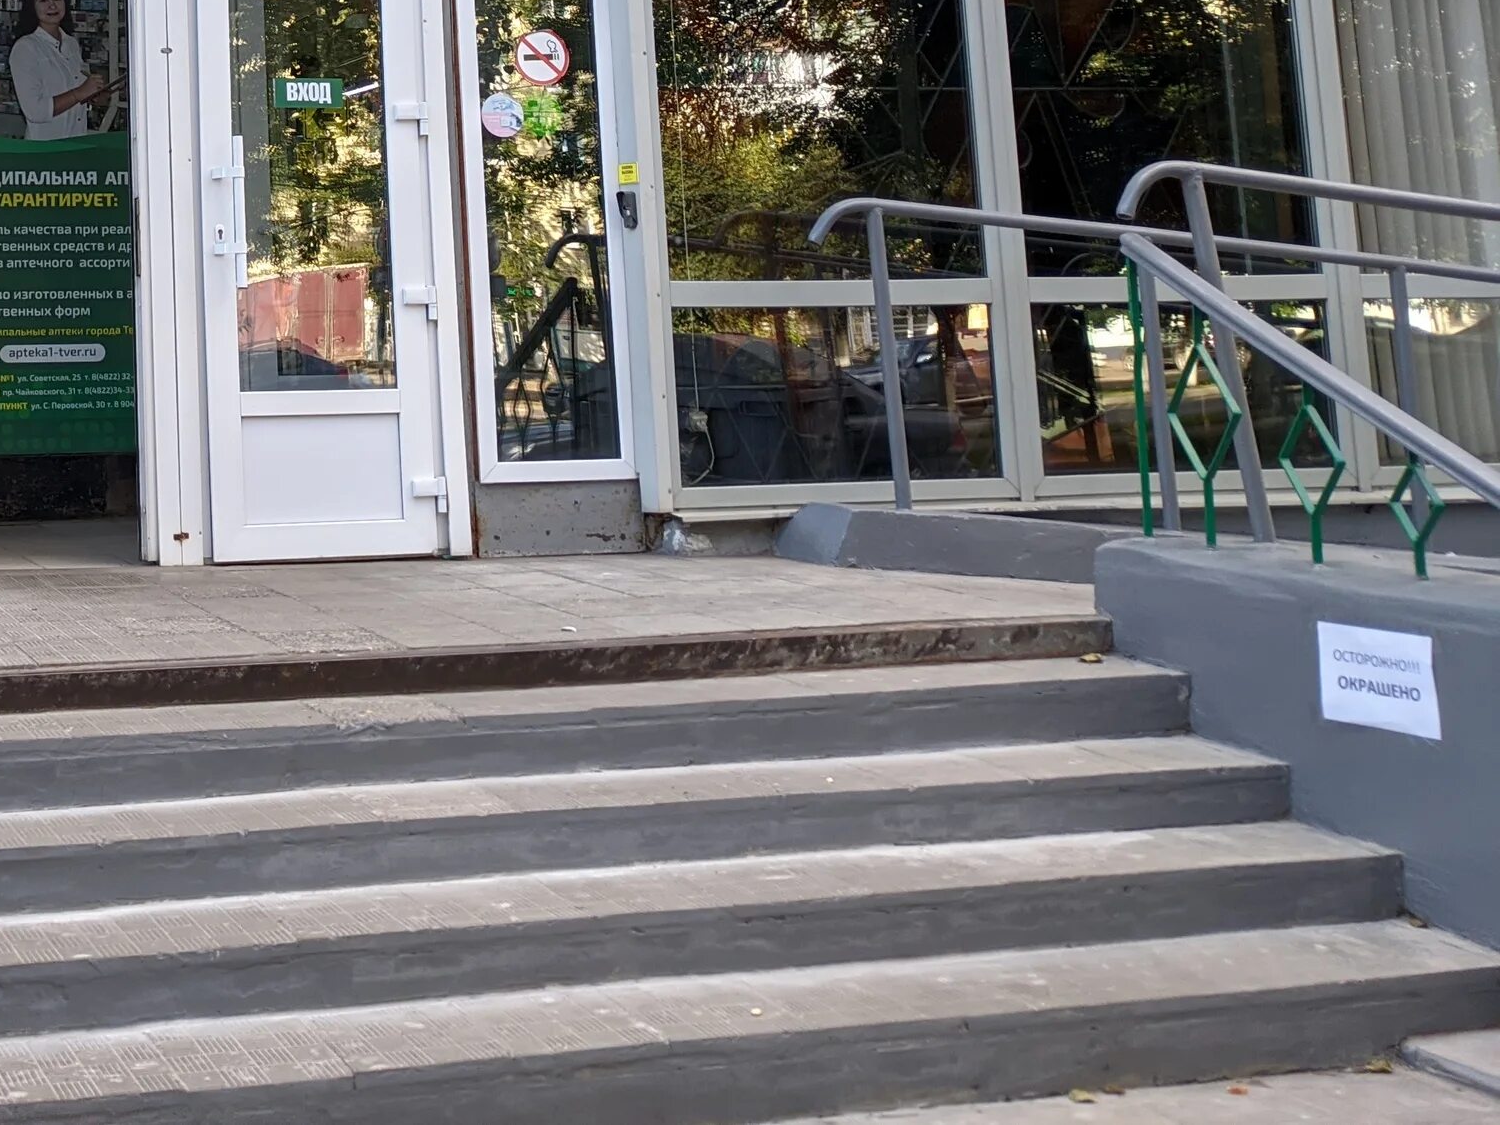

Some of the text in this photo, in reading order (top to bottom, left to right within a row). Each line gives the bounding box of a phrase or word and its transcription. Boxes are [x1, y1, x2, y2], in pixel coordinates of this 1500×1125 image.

[286, 81, 332, 105] ВХОД
[13, 226, 72, 235] качества
[75, 225, 99, 236] при
[53, 242, 105, 253] средств
[107, 242, 116, 251] и
[6, 259, 73, 270] аптечного
[79, 258, 131, 270] ассорти
[13, 289, 113, 300] изготовленных
[116, 289, 124, 299] в
[54, 305, 91, 318] форм
[49, 327, 84, 336] аптеки
[85, 326, 121, 337] города
[8, 346, 97, 360] apteka1-tver.ru
[0, 402, 28, 411] ПУНКТ
[1337, 674, 1422, 703] ОКРАШЕНО
